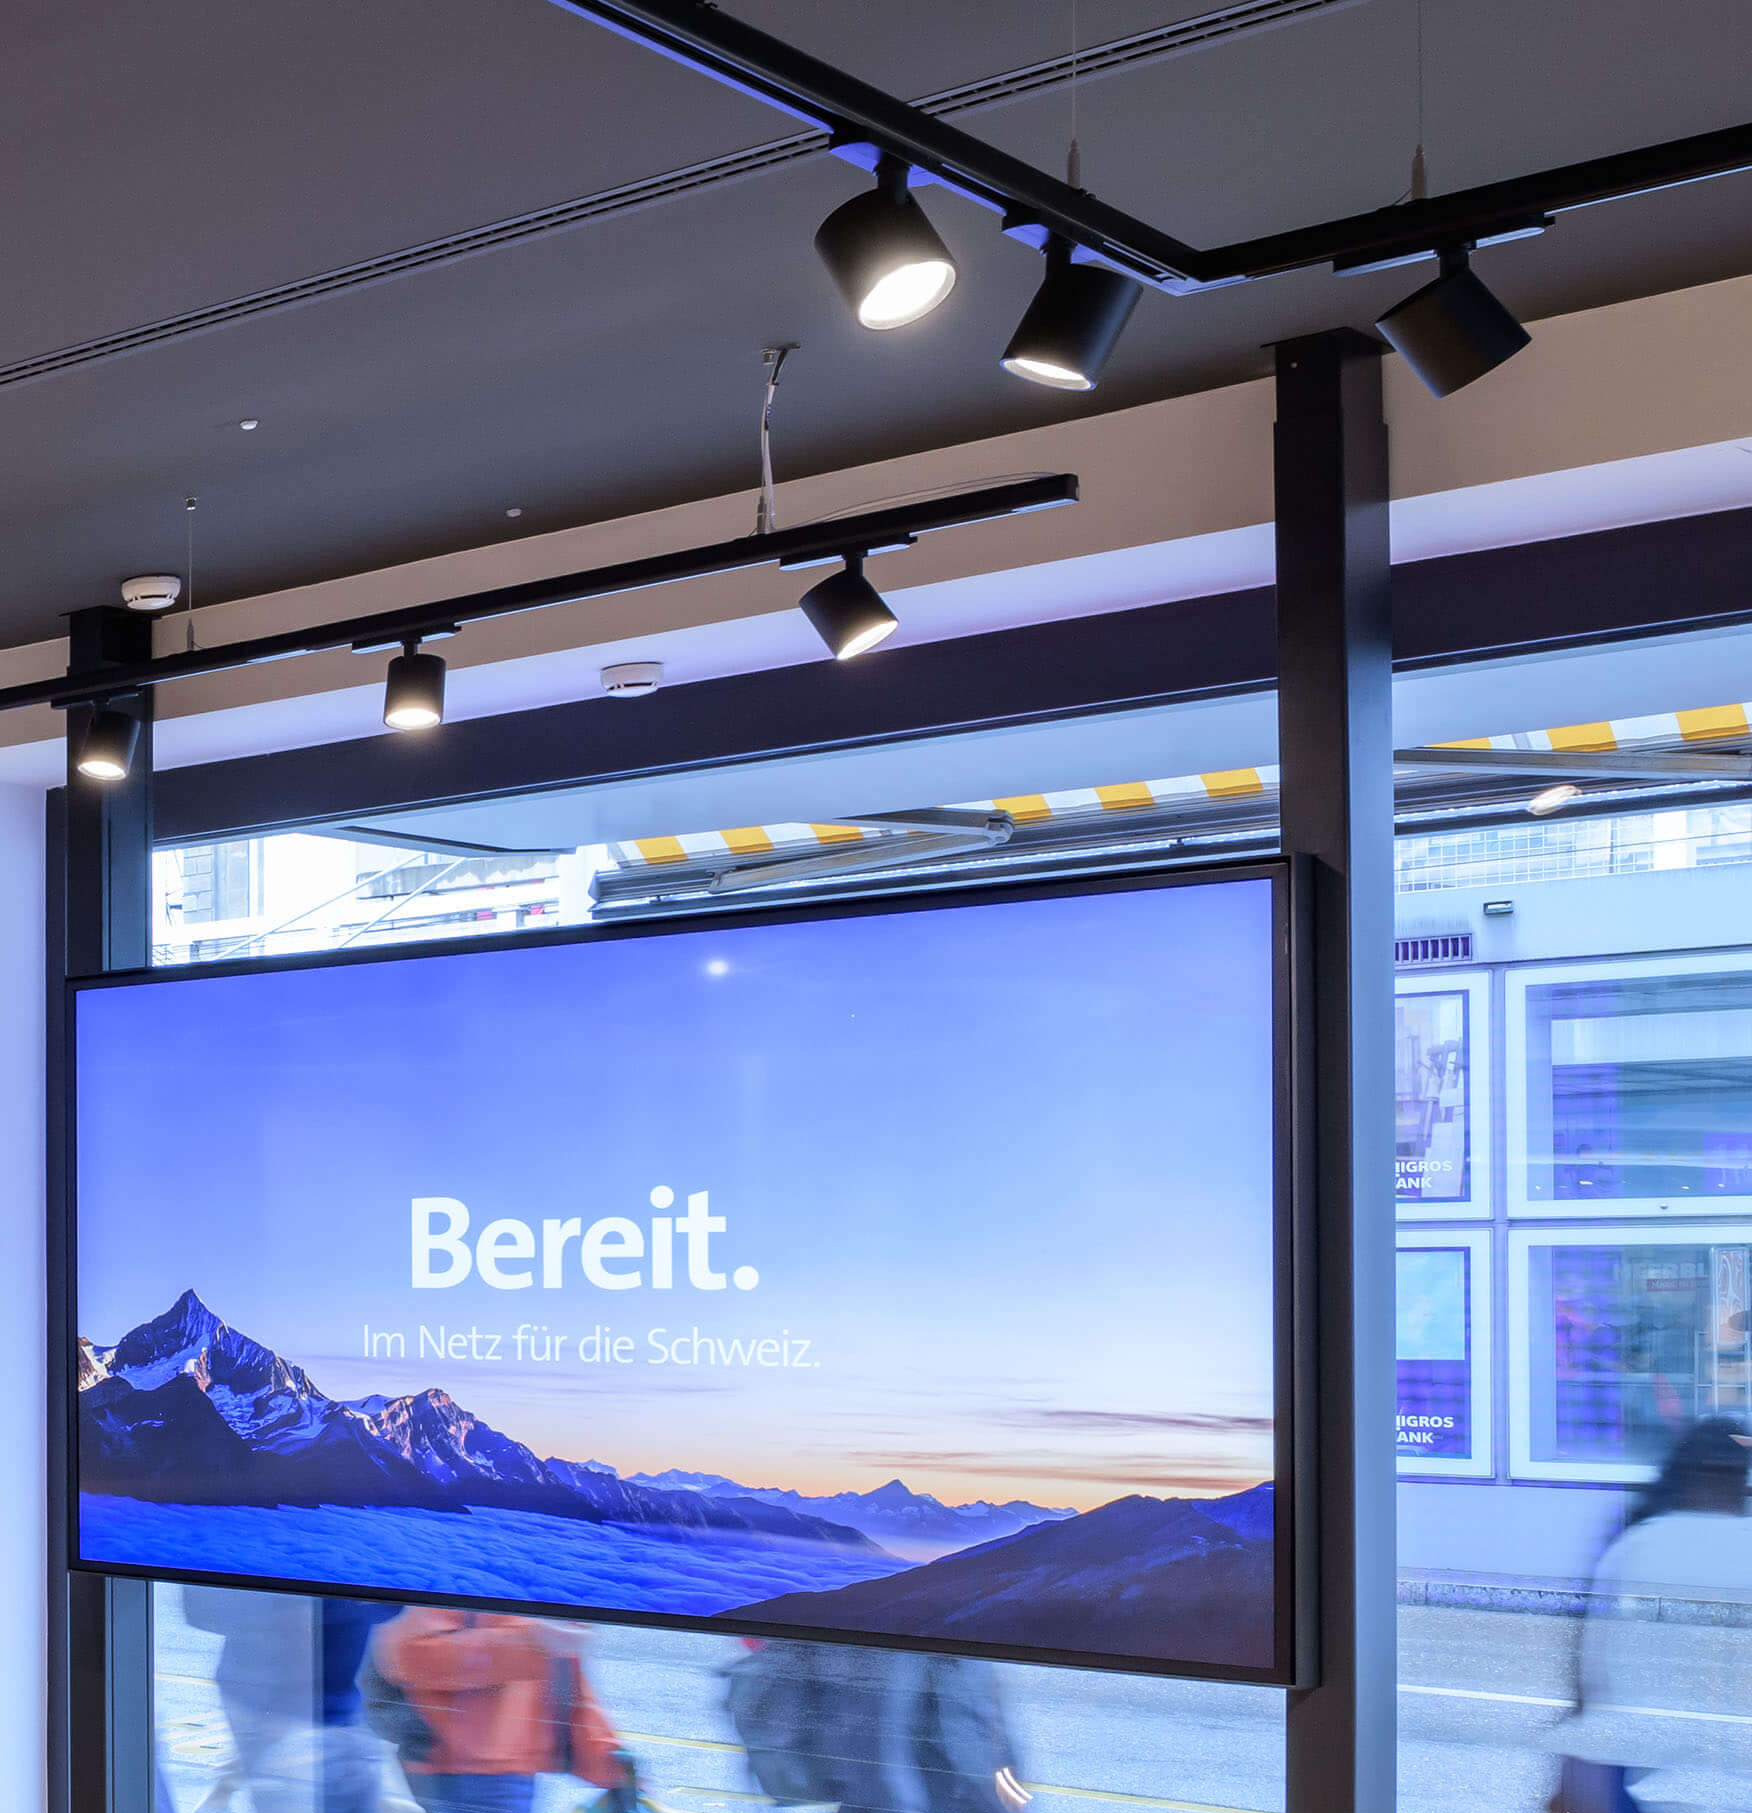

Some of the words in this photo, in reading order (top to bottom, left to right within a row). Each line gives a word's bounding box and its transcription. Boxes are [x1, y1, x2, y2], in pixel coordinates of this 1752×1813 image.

[1395, 1177, 1433, 1189] ANK
[410, 1185, 760, 1291] Bereit.
[363, 1324, 406, 1358] Im
[418, 1324, 502, 1360] Netz
[512, 1323, 568, 1362] für
[578, 1326, 635, 1364] die
[647, 1327, 821, 1368] Schweiz.
[1395, 1431, 1434, 1443] ANK
